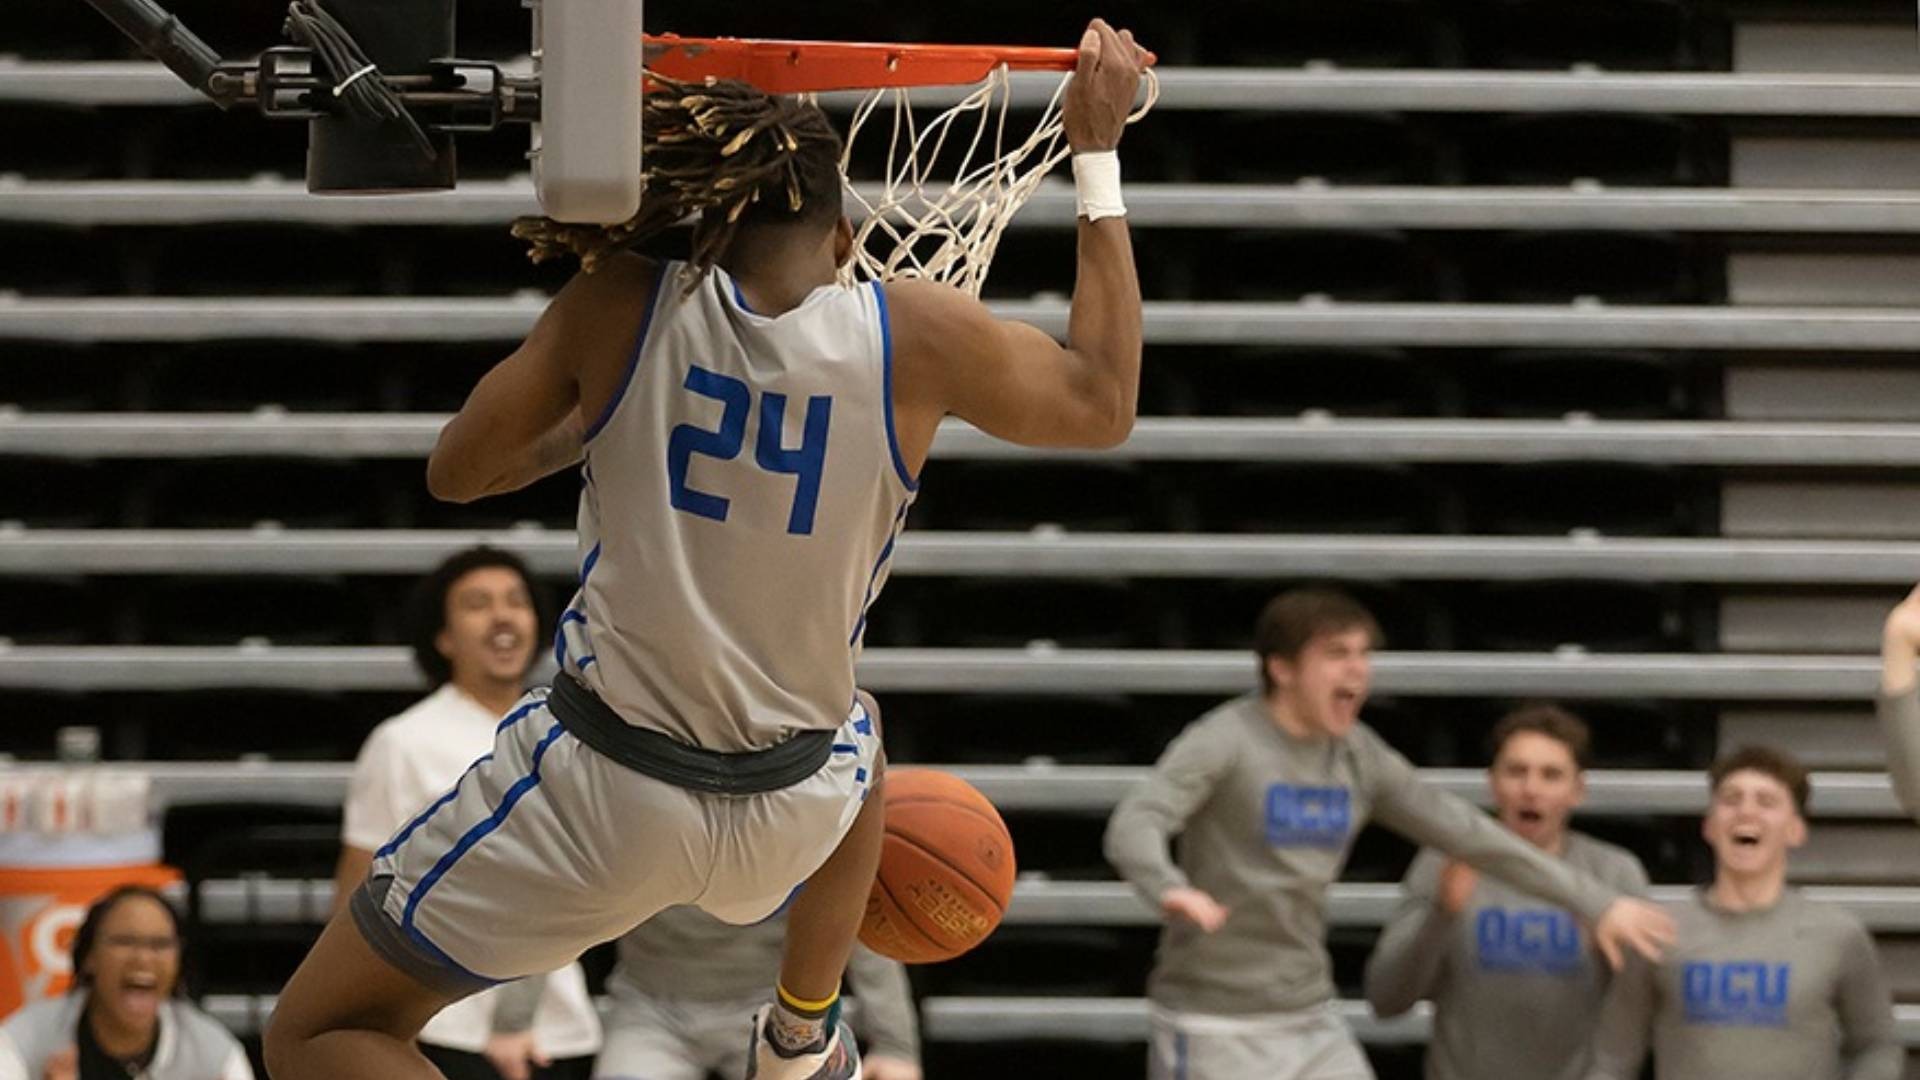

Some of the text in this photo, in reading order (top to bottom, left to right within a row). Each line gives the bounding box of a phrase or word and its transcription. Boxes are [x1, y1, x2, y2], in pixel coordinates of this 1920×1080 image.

[667, 365, 833, 535] 24
[1477, 906, 1580, 958] OCU
[1684, 963, 1789, 1008] OCU
